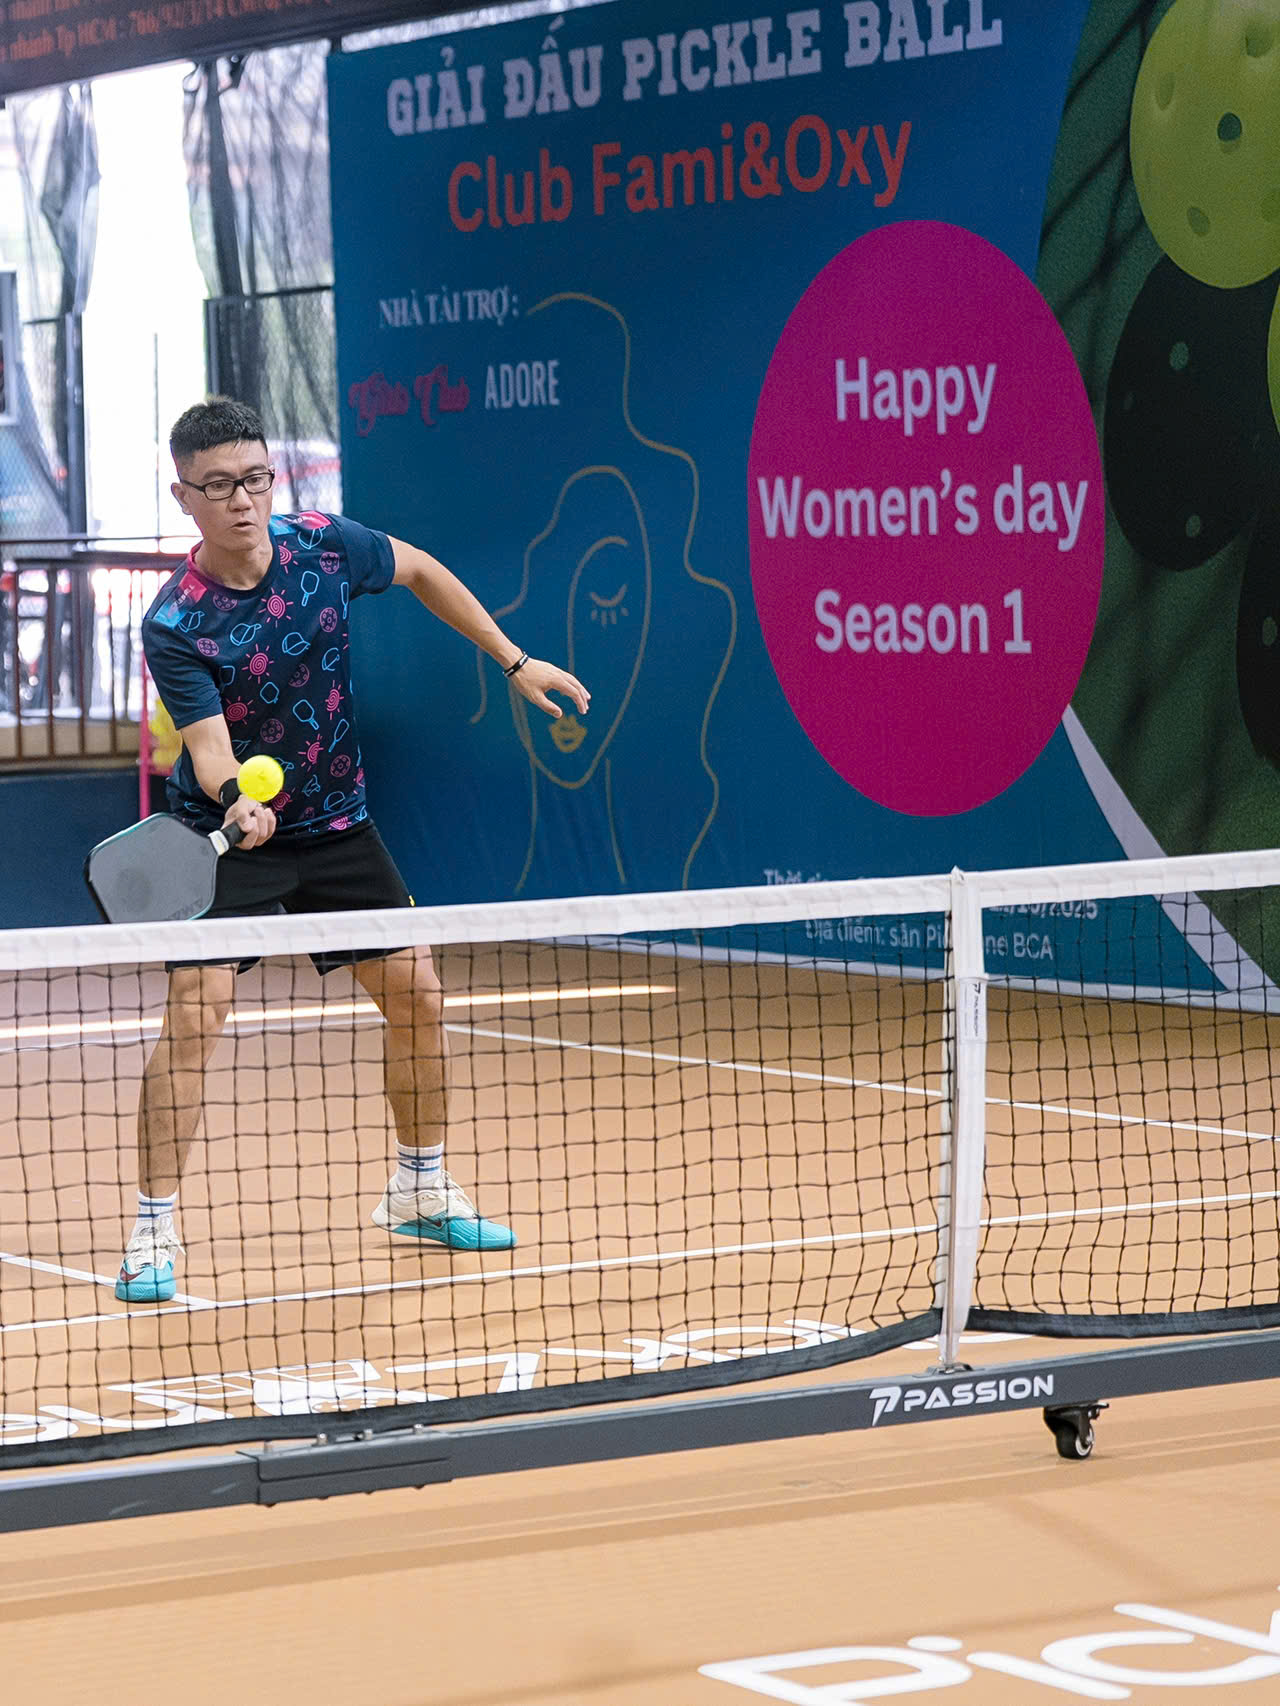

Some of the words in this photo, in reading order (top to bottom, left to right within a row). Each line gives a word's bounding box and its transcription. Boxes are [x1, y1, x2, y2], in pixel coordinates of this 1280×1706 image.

[387, 47, 485, 136] GIẢI
[503, 15, 603, 119] ĐẤU
[622, 9, 821, 101] PICKLE
[844, 0, 1002, 67] BALL
[448, 148, 572, 232] Club
[593, 115, 912, 215] Fami&Oxy
[379, 288, 423, 328] NHÀ
[424, 285, 460, 325] TÀI
[484, 360, 560, 409] ADORE
[835, 357, 997, 437] Happy
[757, 467, 979, 538] Women's
[993, 464, 1089, 552] day
[814, 589, 989, 654] Season
[1003, 588, 1032, 654] 1
[1013, 932, 1054, 960] BCA
[904, 1373, 1054, 1412] PASSION
